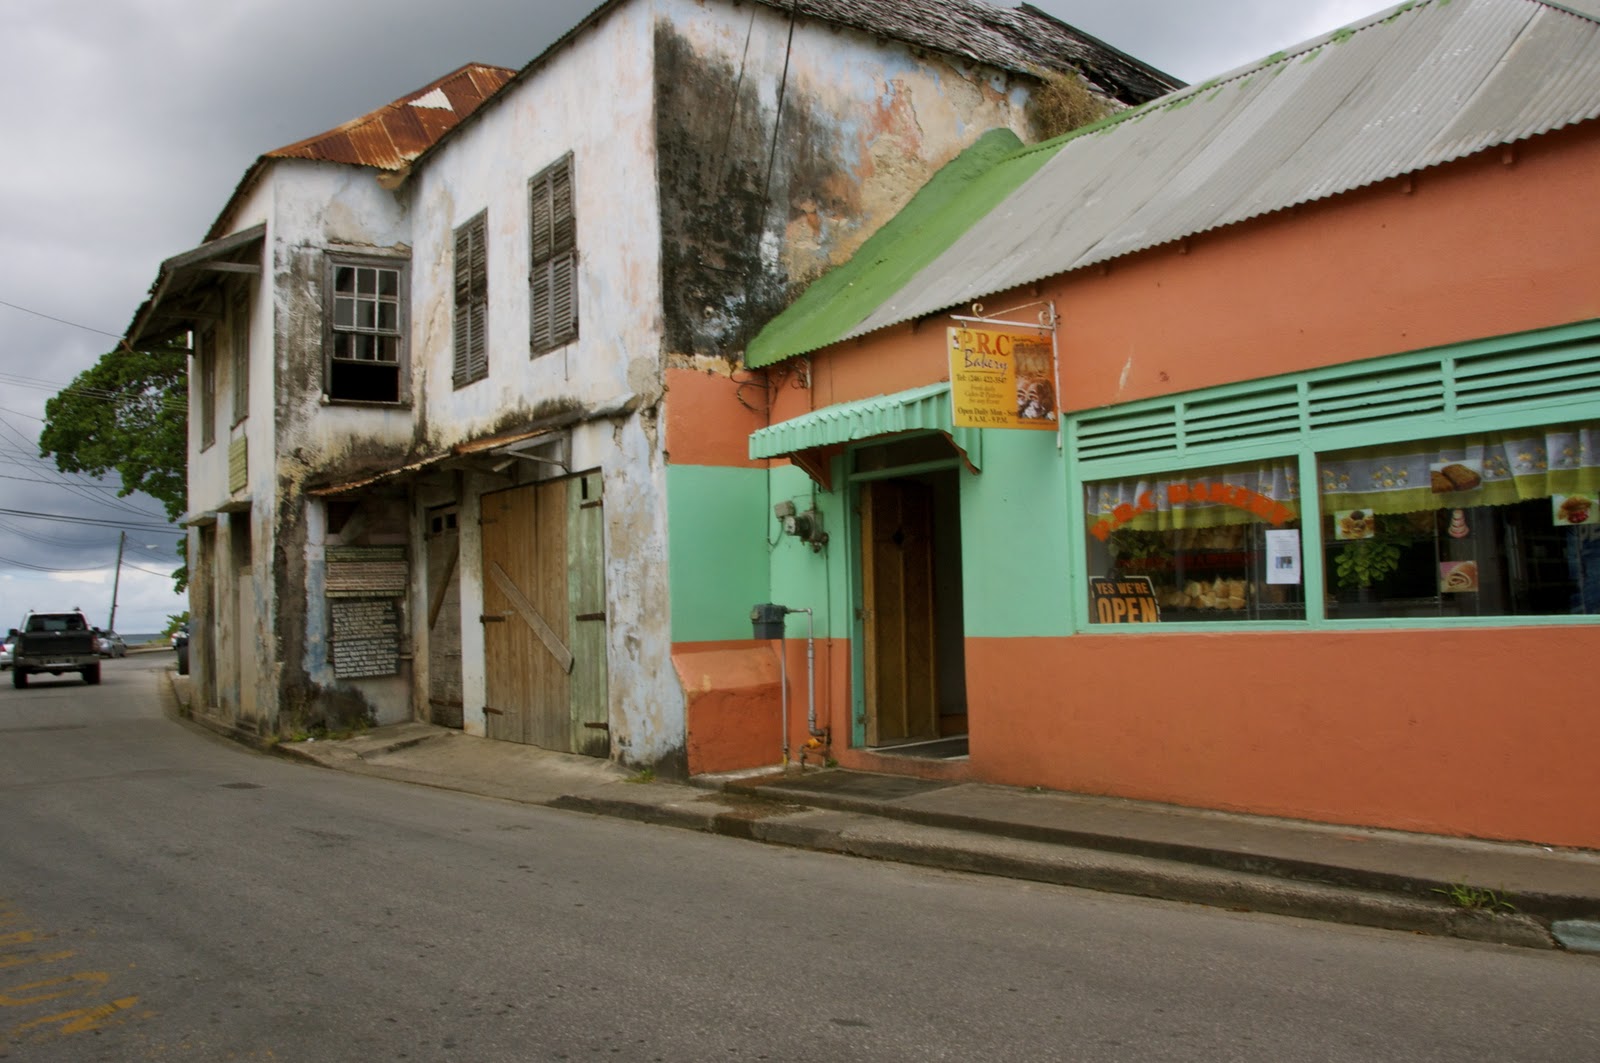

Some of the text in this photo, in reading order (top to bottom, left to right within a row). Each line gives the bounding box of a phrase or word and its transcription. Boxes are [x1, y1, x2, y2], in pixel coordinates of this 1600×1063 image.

[964, 348, 1008, 376] Bakery
[957, 407, 974, 415] Open
[974, 408, 989, 416] Daily
[1095, 582, 1150, 595] YES WE'RE
[1097, 596, 1157, 624] OPEN
